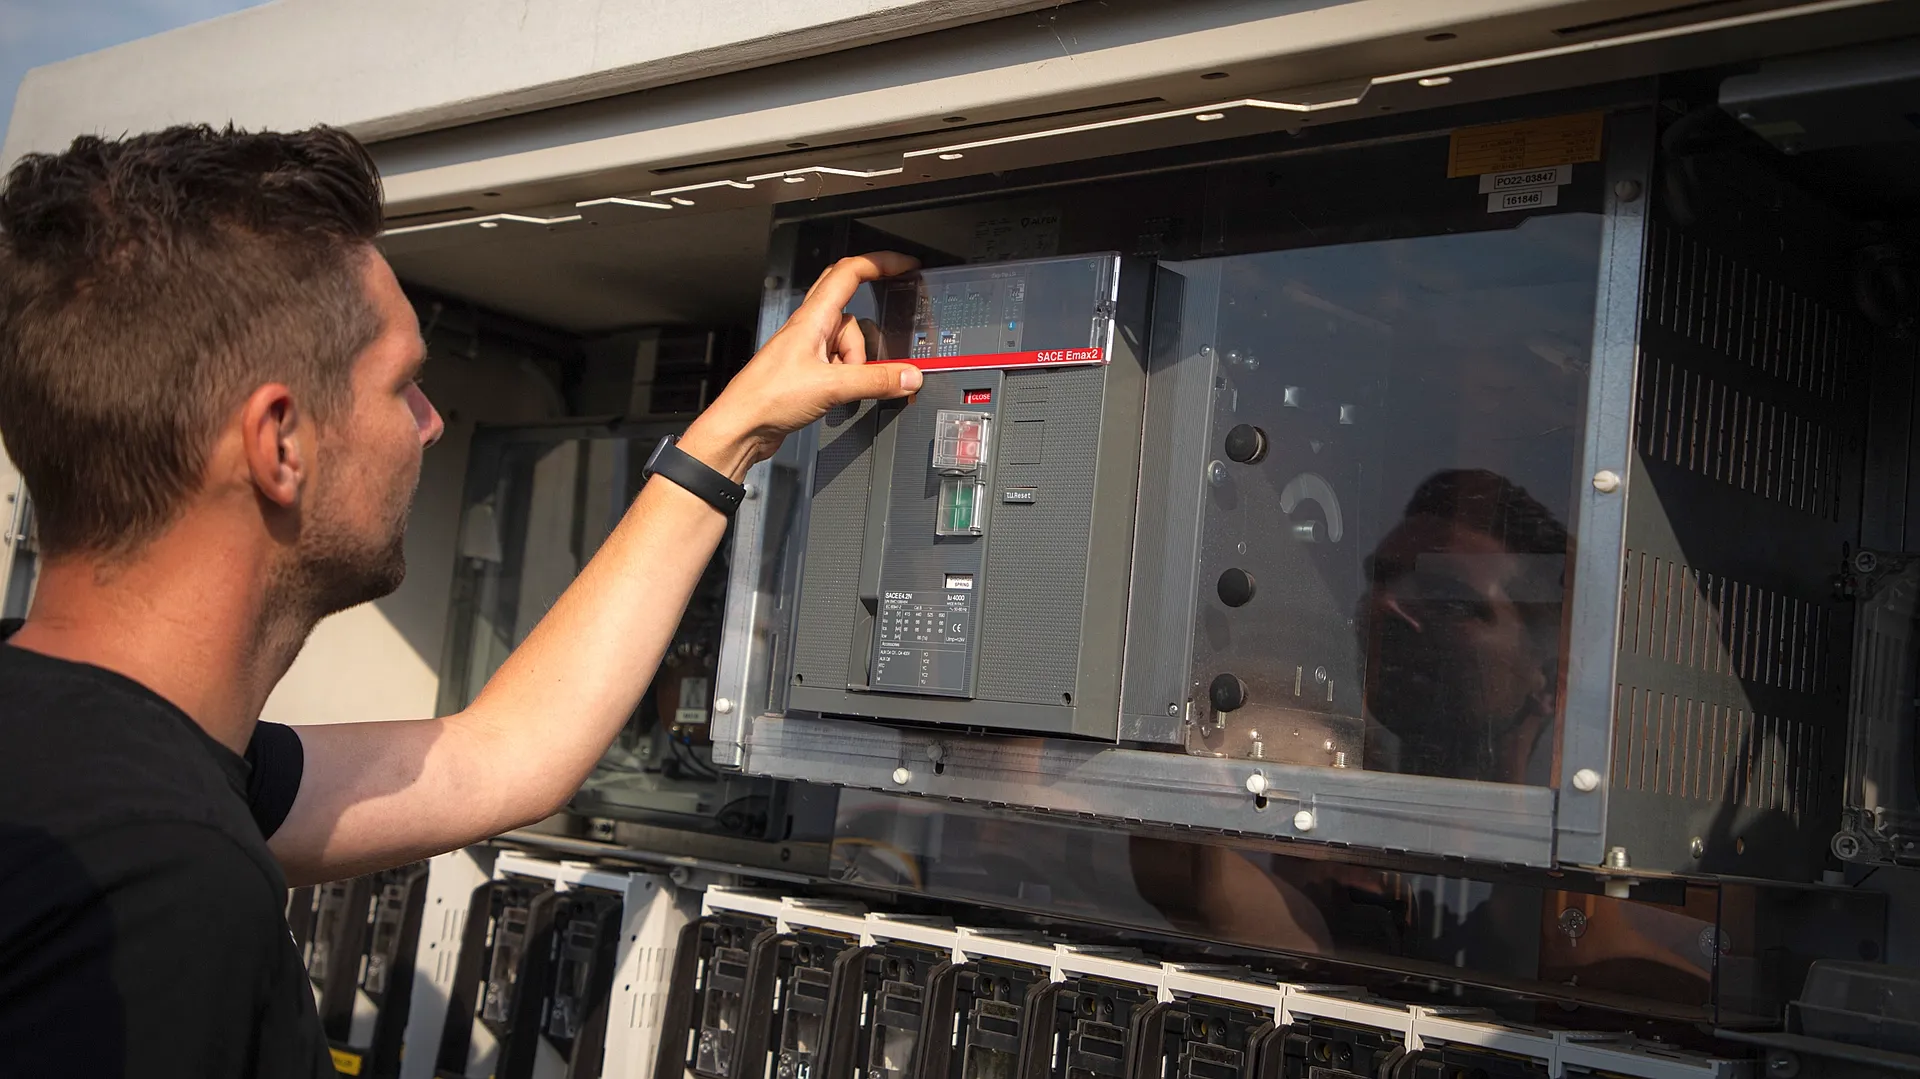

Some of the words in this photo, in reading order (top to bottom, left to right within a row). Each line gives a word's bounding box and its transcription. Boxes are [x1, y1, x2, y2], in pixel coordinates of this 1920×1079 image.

[1497, 172, 1553, 187] PO22-03847
[1506, 194, 1539, 205] 161846
[1037, 351, 1064, 362] SACE
[1065, 349, 1098, 361] Emax2
[971, 393, 991, 401] CLOSE
[797, 1063, 810, 1079] L1
